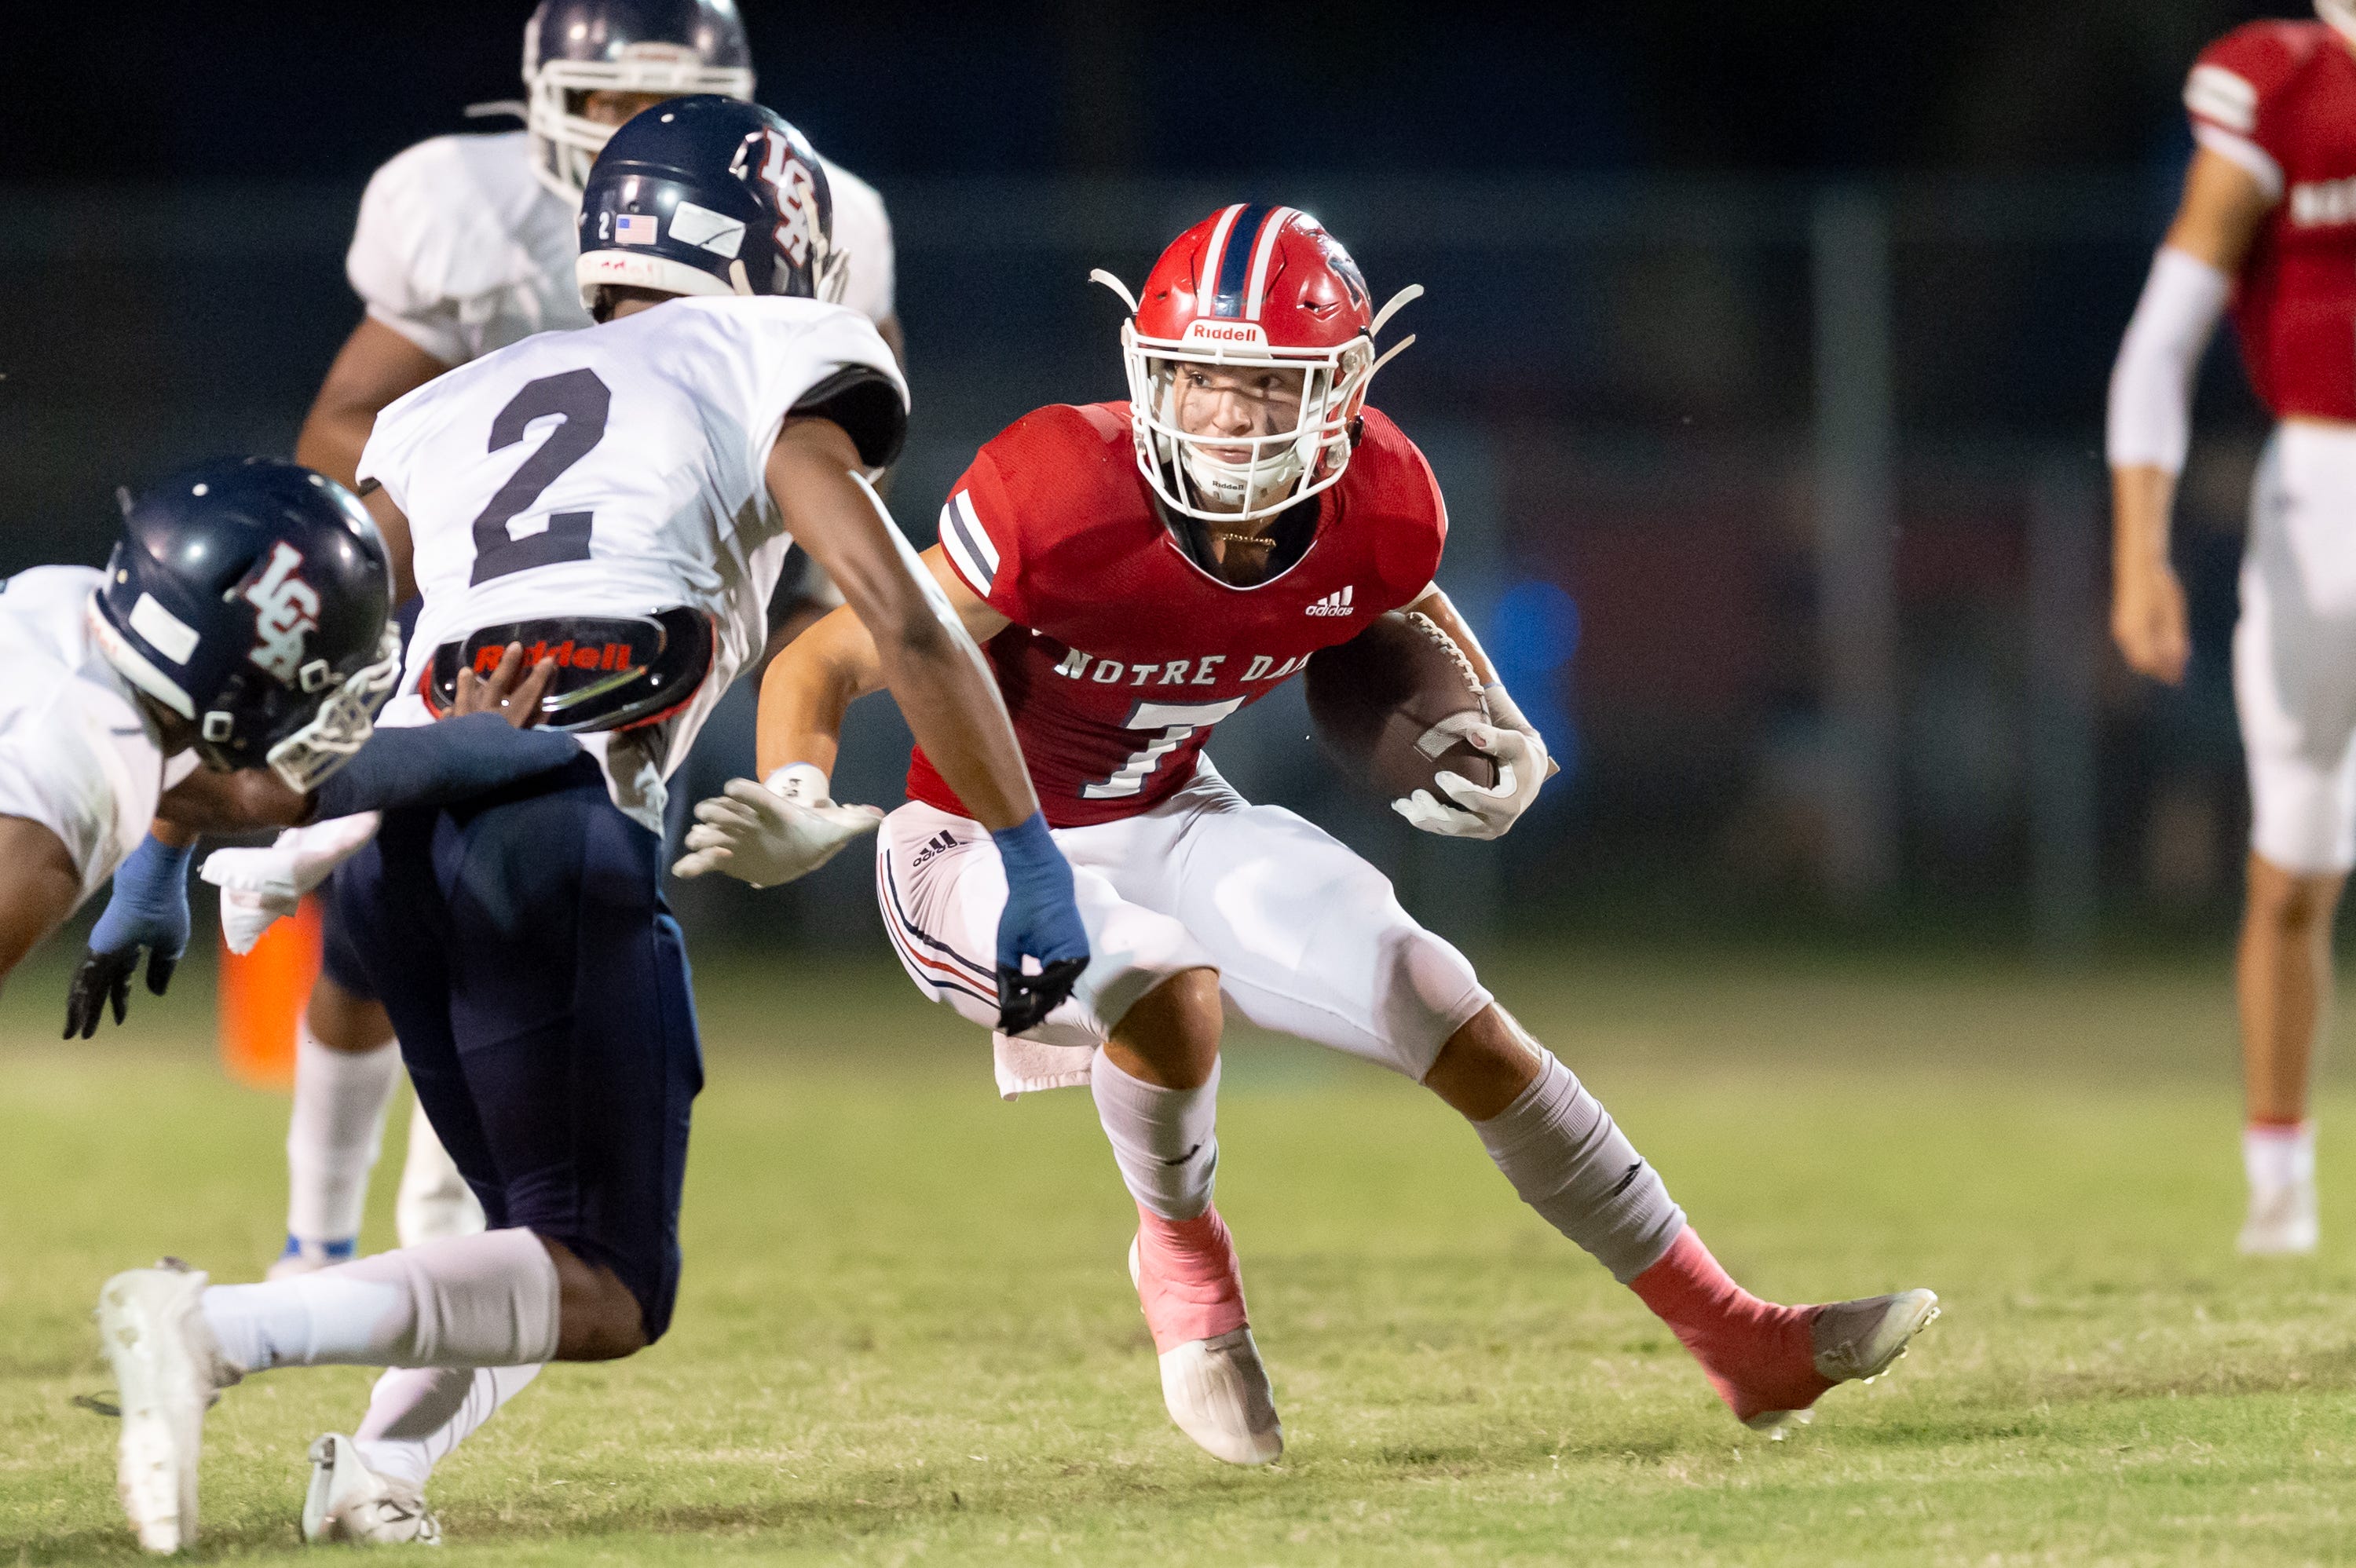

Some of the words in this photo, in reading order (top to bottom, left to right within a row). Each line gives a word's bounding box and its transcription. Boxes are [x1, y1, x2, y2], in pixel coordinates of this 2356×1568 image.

[598, 211, 609, 239] 2
[1194, 324, 1256, 342] Riddell
[470, 367, 611, 588] 2
[1212, 480, 1245, 490] Riddell
[1305, 604, 1354, 616] adidas
[474, 640, 632, 673] Rddell
[1054, 647, 1226, 686] NOTRE
[1079, 695, 1248, 799] 7
